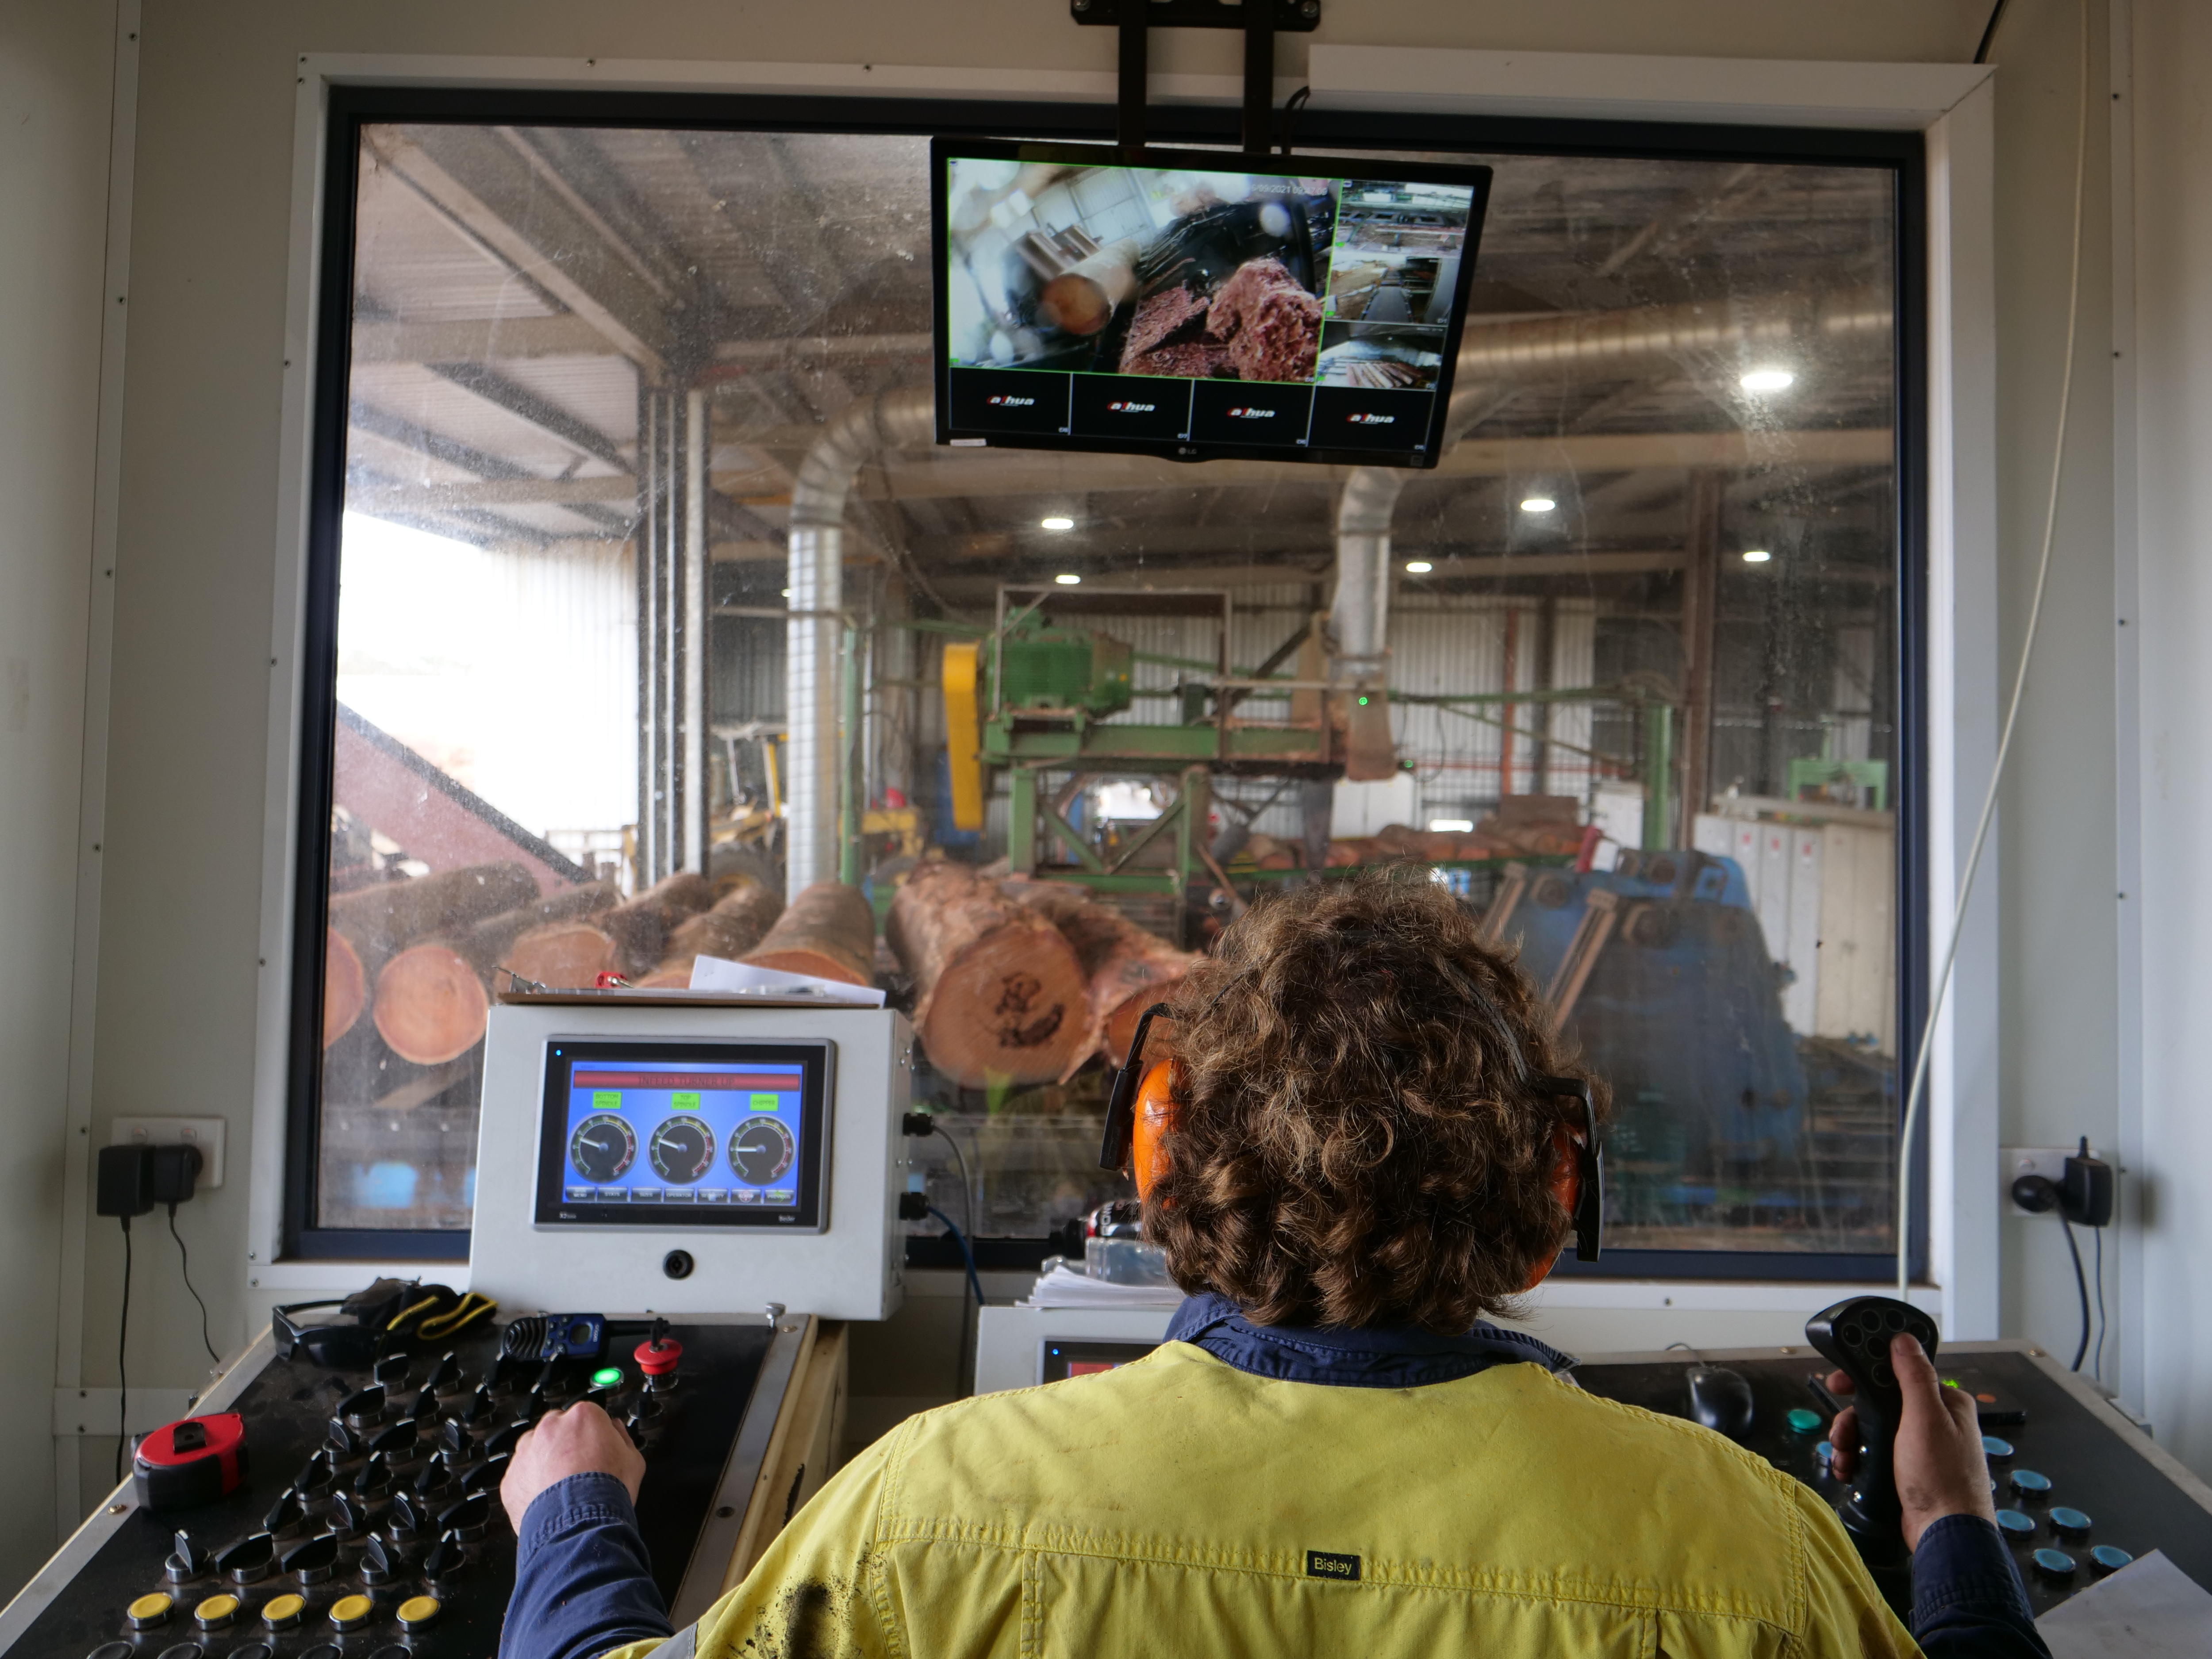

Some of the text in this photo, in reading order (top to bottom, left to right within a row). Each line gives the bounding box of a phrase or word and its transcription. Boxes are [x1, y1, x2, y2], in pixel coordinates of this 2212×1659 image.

[638, 1076, 734, 1087] INFEED TURNER UP
[1314, 1557, 1352, 1575] Bisley
